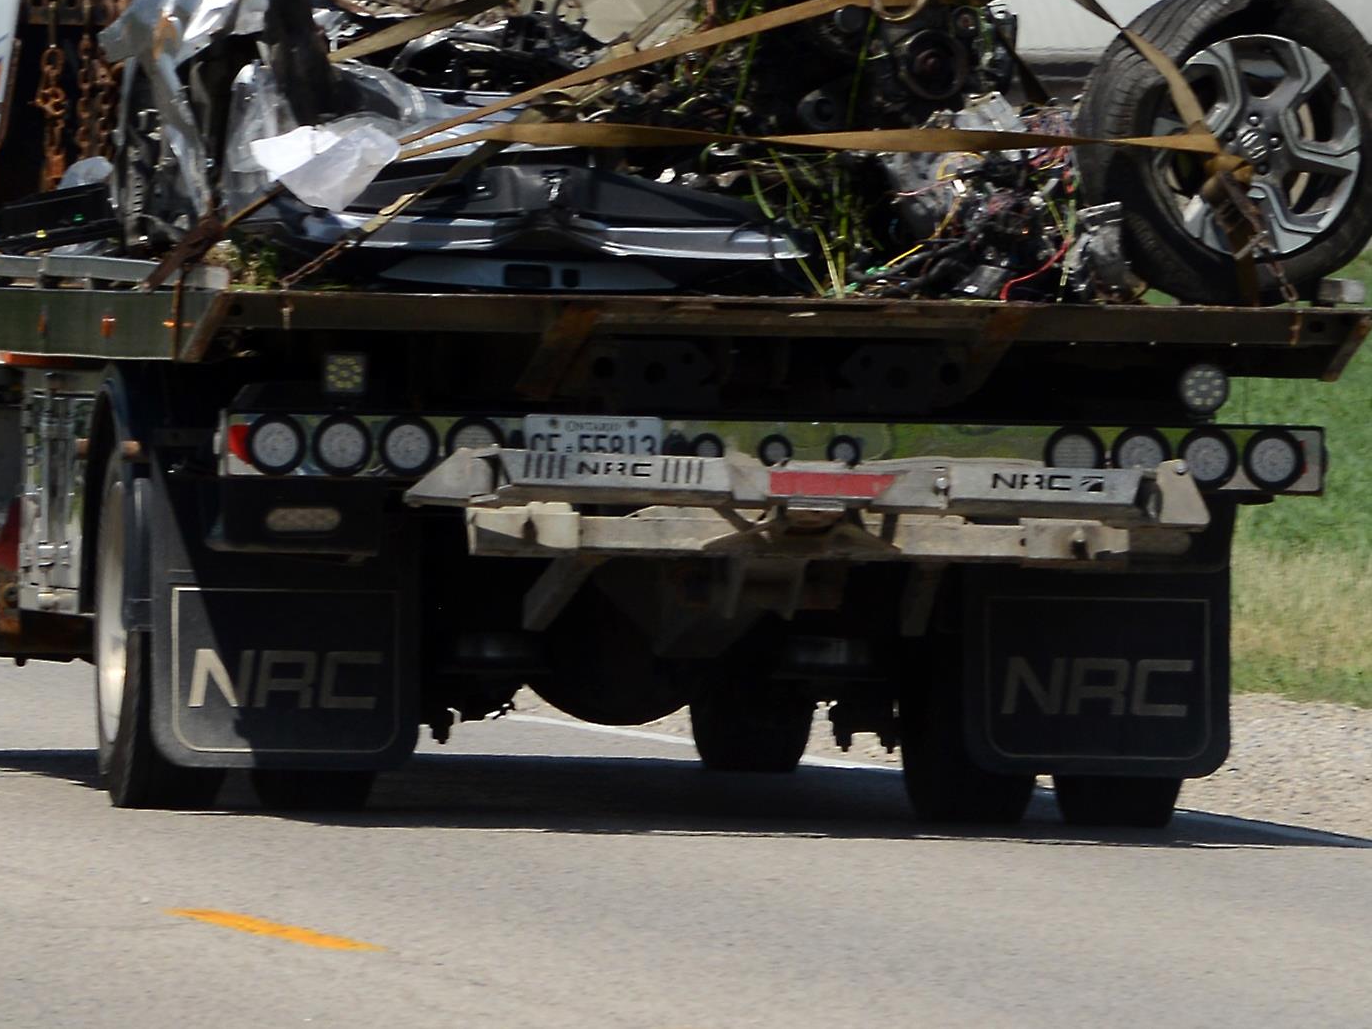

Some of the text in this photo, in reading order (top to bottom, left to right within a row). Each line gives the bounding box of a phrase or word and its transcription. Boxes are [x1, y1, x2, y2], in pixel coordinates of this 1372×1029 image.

[577, 461, 653, 478] NRC
[991, 473, 1073, 491] NRC
[187, 648, 384, 710] NRC
[1000, 656, 1194, 717] NRC
